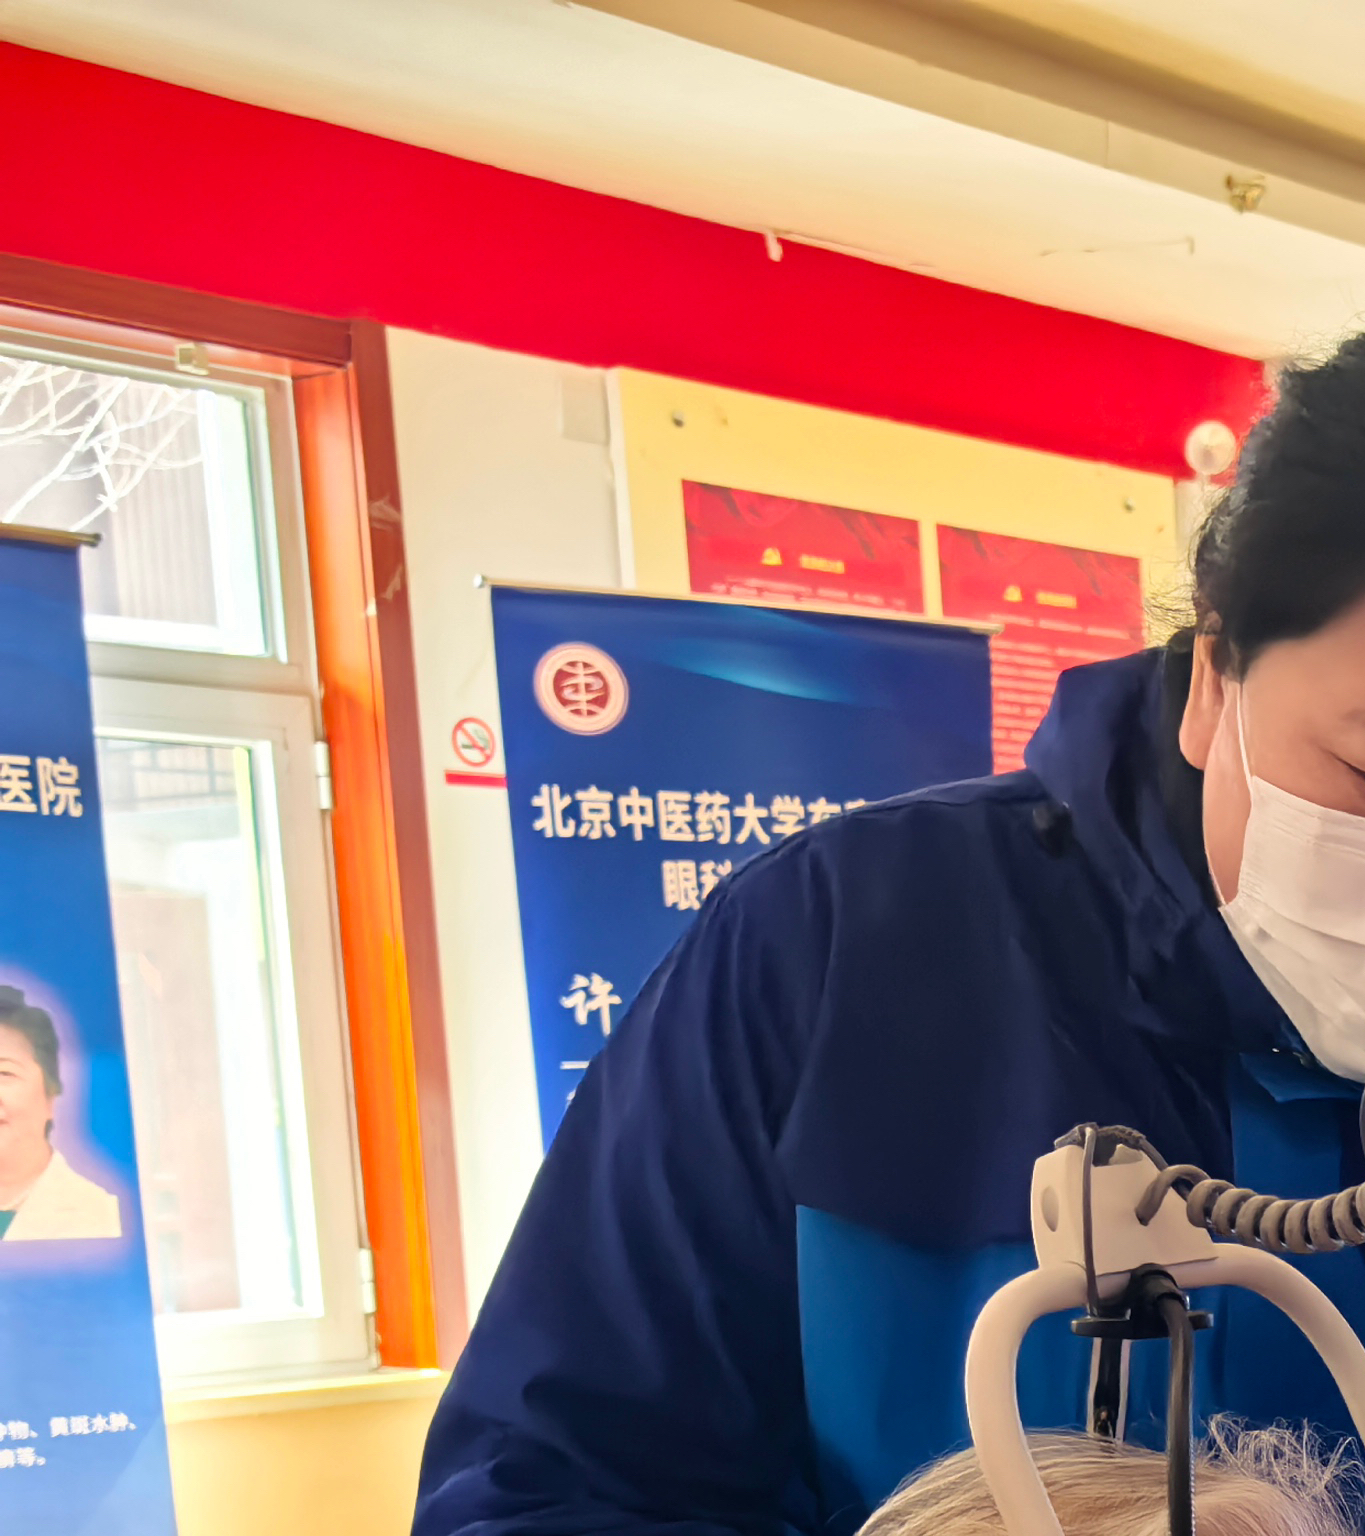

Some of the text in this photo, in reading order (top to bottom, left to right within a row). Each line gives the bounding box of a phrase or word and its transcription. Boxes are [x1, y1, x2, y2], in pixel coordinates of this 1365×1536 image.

[0, 755, 82, 818] 医院
[532, 783, 866, 845] 北京中医药大学
[560, 972, 623, 1036] 许
